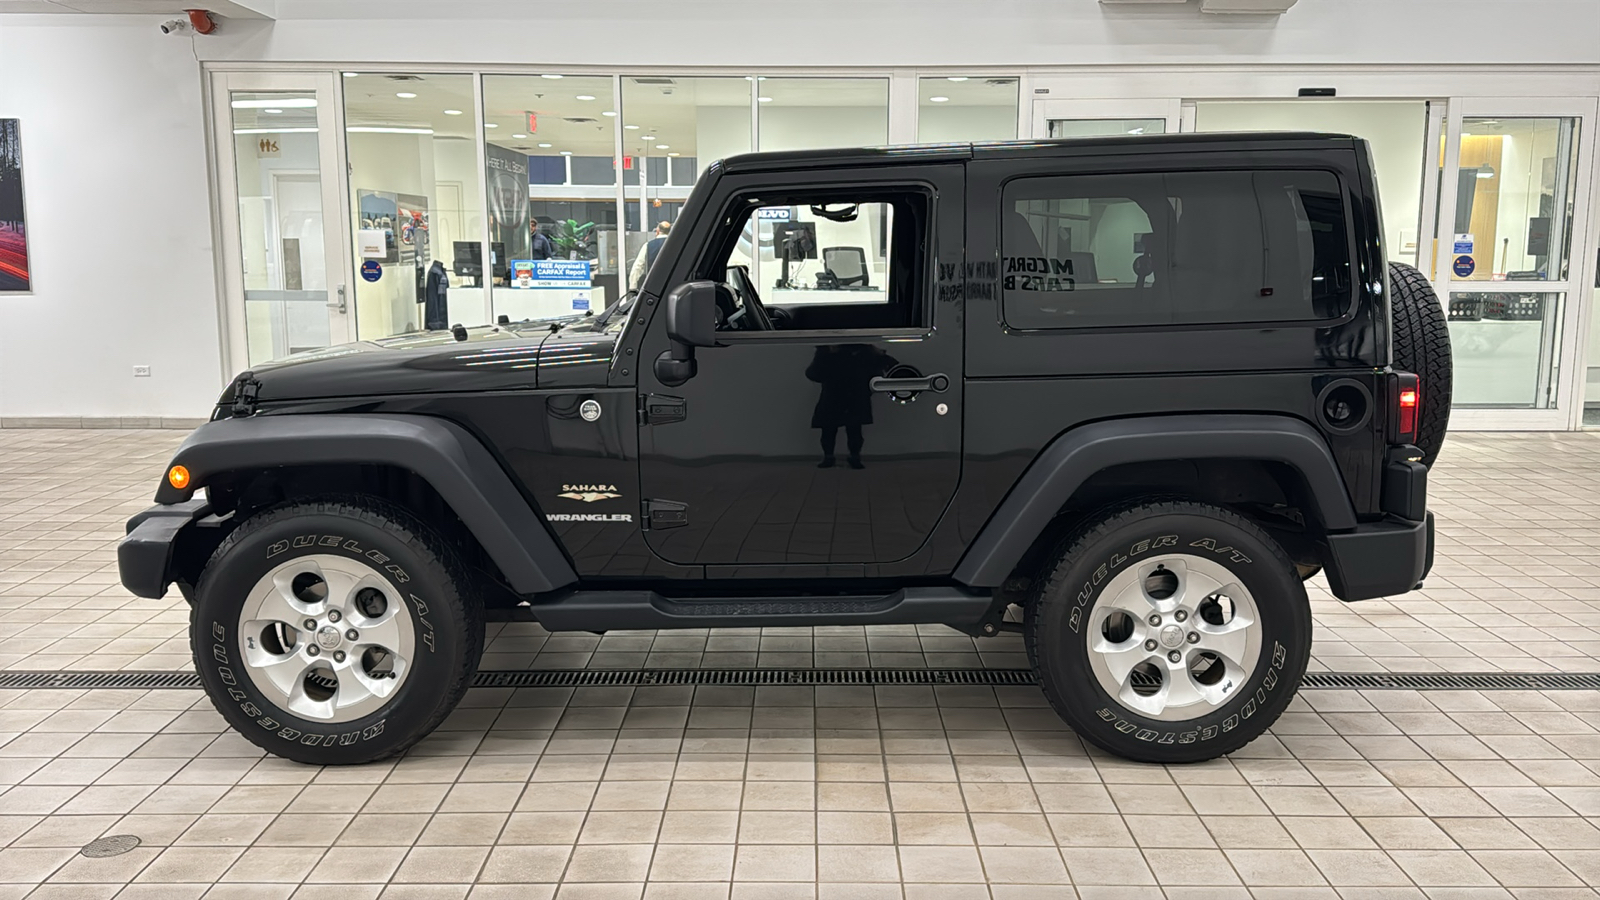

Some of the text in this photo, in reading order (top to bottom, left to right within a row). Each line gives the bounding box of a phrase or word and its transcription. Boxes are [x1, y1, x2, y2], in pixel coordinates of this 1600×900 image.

[758, 209, 790, 219] LVO
[554, 262, 580, 271] Appraisal
[565, 269, 587, 277] Report
[562, 484, 618, 492] SAHARA
[546, 514, 633, 523] WRANGLER
[1068, 535, 1253, 633] DUELER A/T
[266, 534, 435, 653] DUELER A/T
[212, 621, 387, 747] BRIDGESTONE
[1095, 640, 1287, 745] BRIDGESTONE
